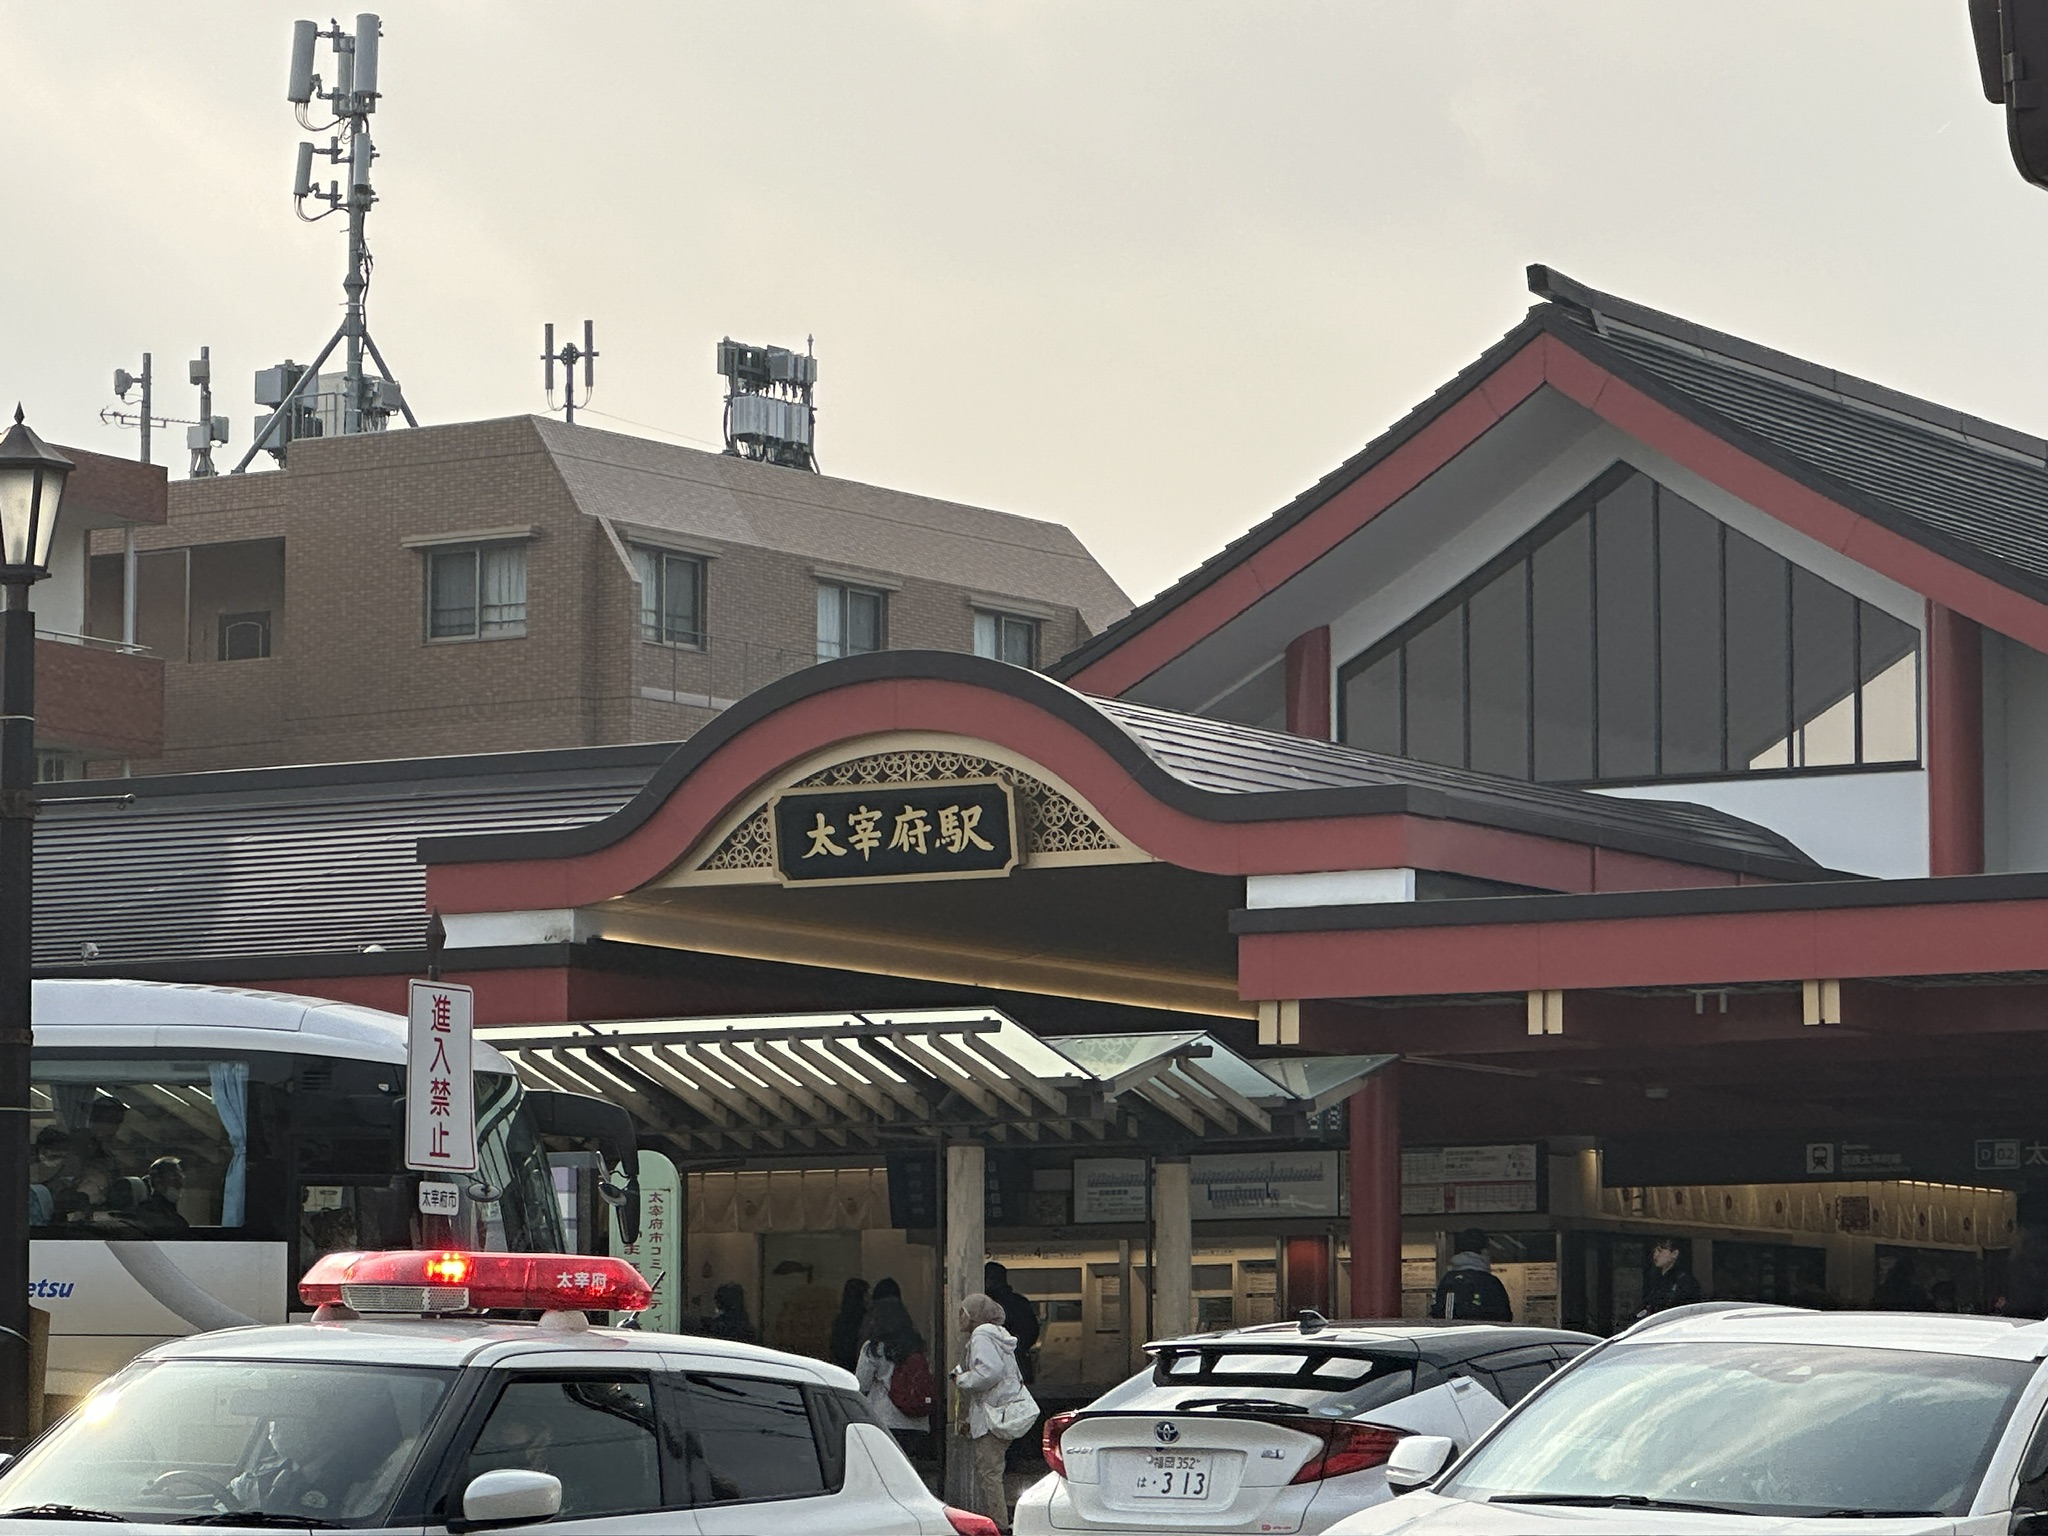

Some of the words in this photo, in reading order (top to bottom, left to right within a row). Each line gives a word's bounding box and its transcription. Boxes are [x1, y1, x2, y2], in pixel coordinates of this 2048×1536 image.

[802, 805, 995, 861] 太宰府駅
[429, 994, 451, 1158] 進入禁止
[422, 1190, 457, 1208] 太宰府市
[28, 1279, 75, 1298] etsu
[557, 1271, 607, 1289] 太宰府
[1176, 1456, 1196, 1470] 352
